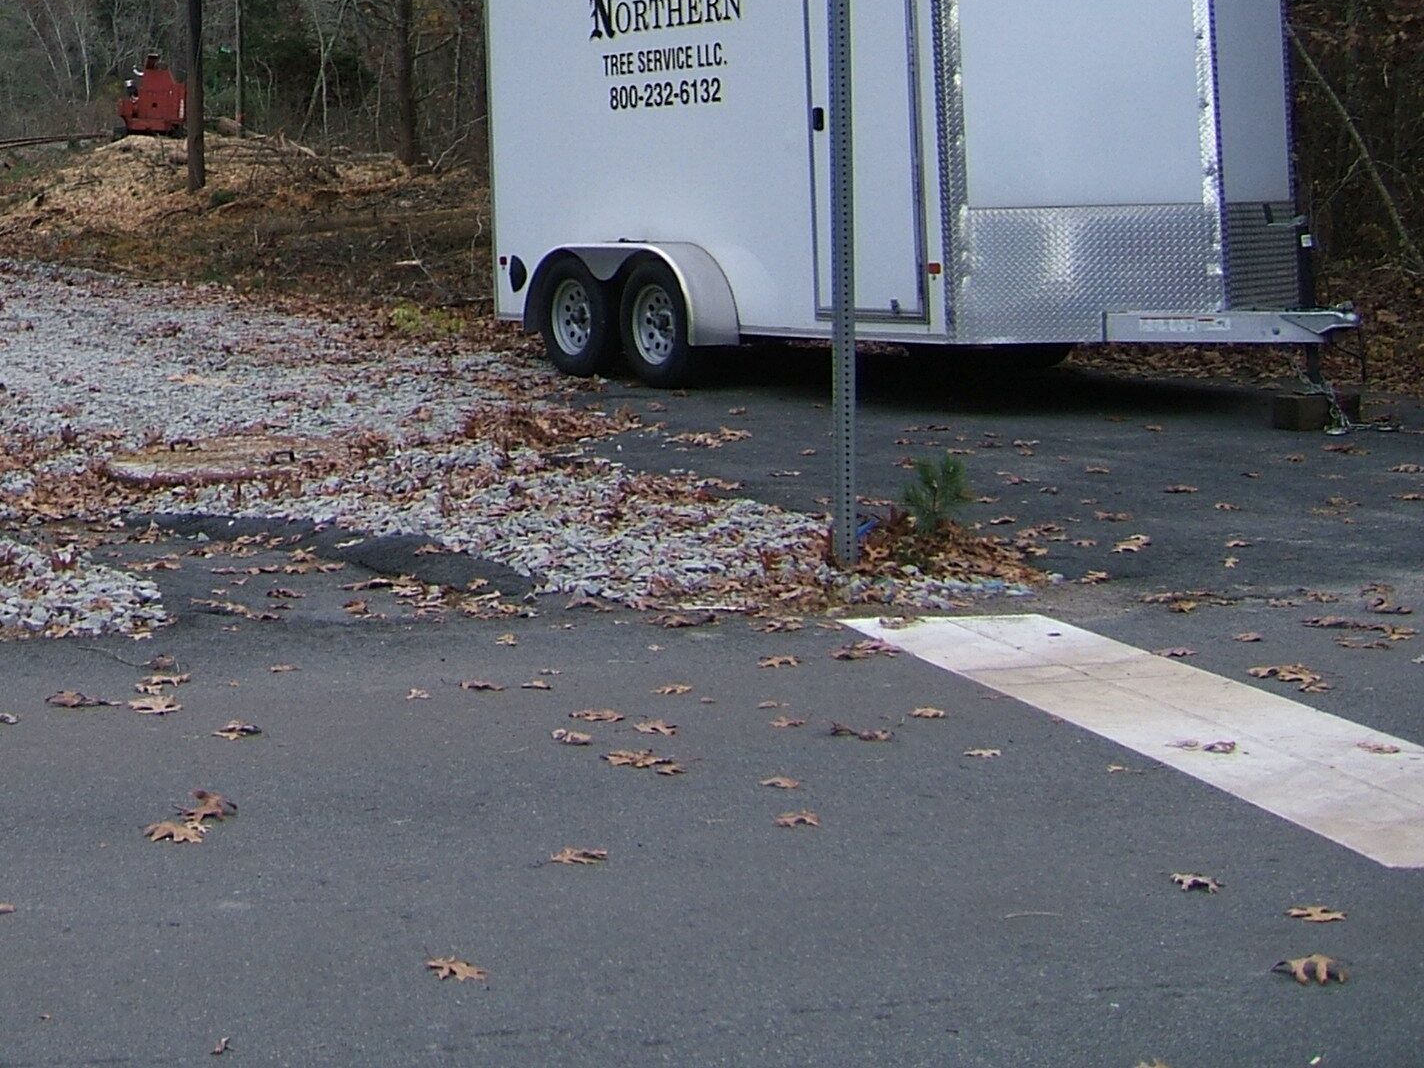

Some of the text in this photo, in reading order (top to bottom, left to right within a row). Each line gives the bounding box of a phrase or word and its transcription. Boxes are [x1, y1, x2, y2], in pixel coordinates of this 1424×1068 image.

[603, 42, 728, 76] TREE SERVICE LLC.
[610, 77, 722, 110] 800-232-6132
